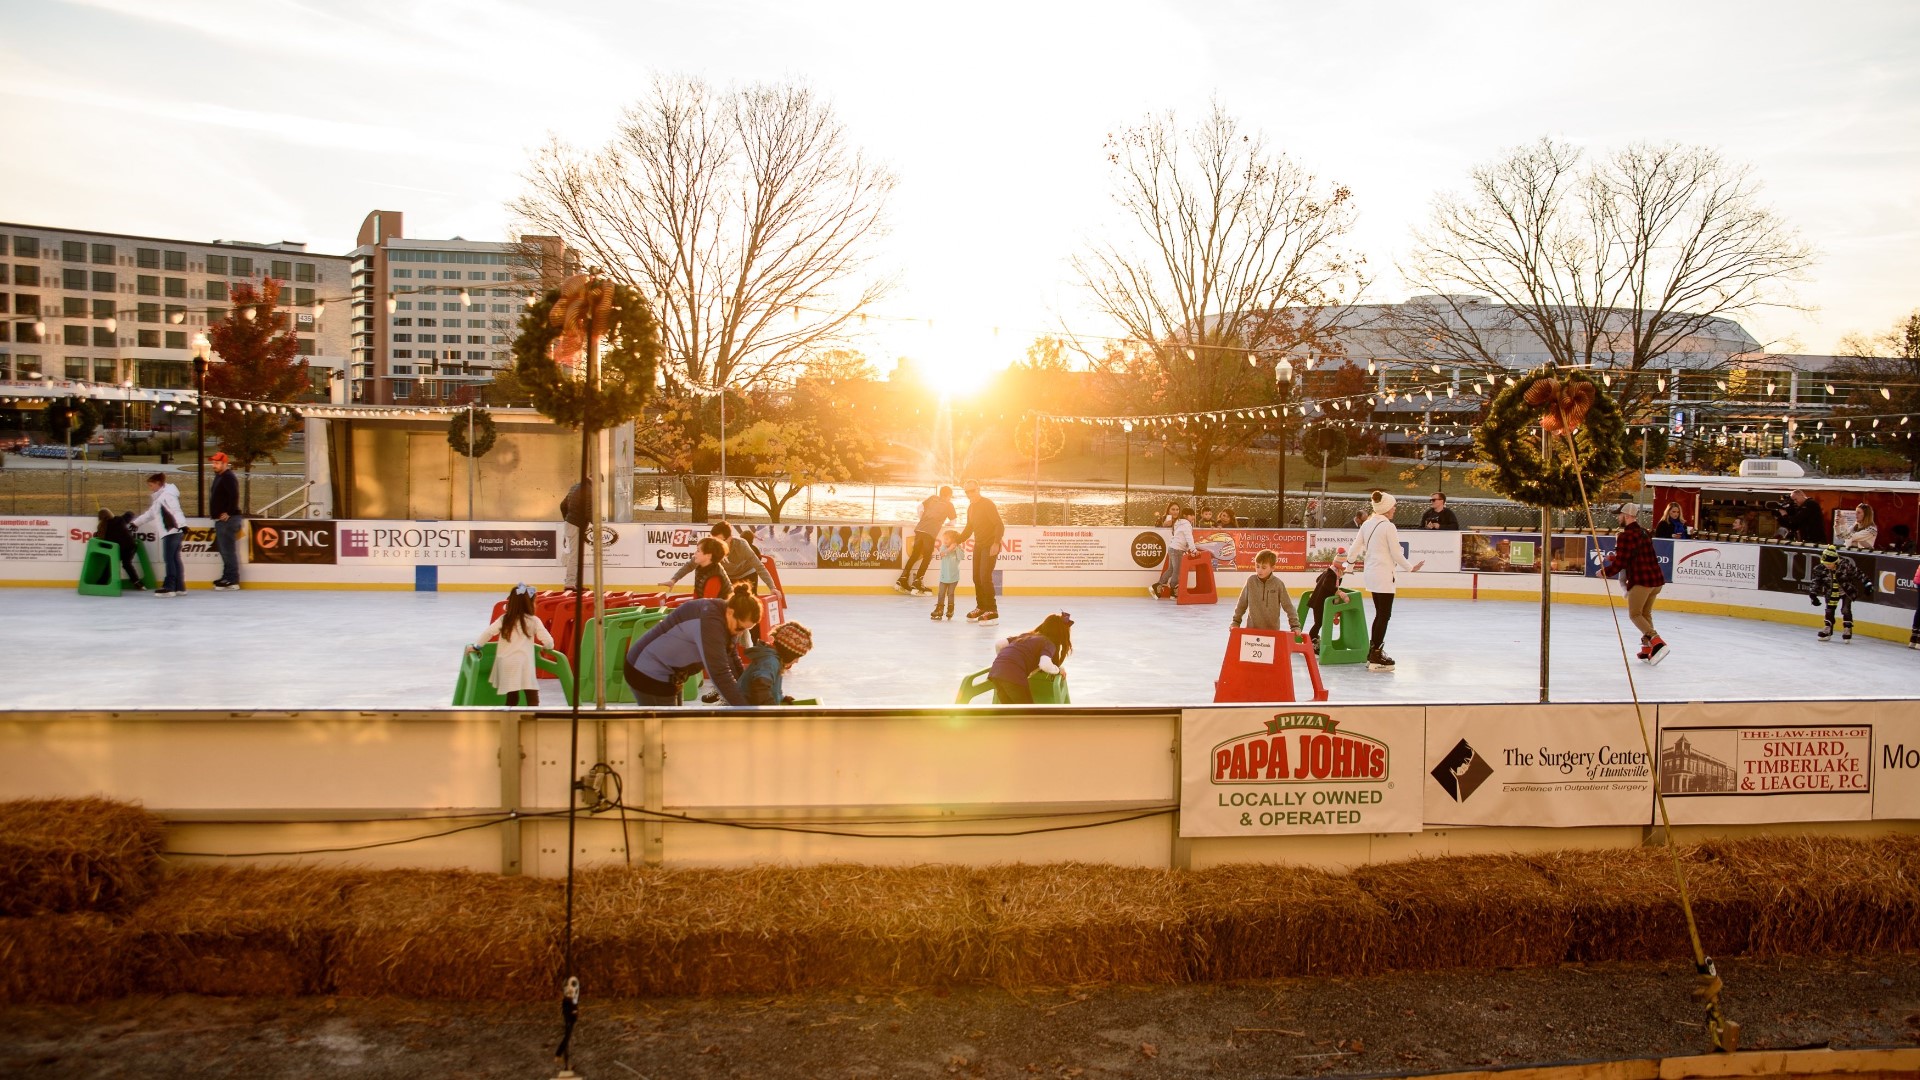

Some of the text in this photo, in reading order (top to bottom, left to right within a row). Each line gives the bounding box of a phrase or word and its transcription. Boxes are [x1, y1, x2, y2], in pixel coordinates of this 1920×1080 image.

[282, 530, 329, 547] PNC
[373, 529, 466, 548] PROPST
[510, 537, 549, 547] Sotheby's
[647, 531, 673, 544] WAAY
[673, 530, 691, 546] 31
[1273, 533, 1305, 542] Coupons
[1238, 541, 1245, 549] &
[1246, 541, 1267, 549] More,
[1270, 541, 1283, 549] Inc.
[1512, 546, 1521, 556] H
[373, 550, 466, 558] PROPERTIES
[656, 549, 695, 560] Cover
[823, 549, 849, 560] Blessed
[860, 550, 871, 558] the
[1690, 559, 1756, 572] HALL ALBRIGHT
[1676, 567, 1716, 576] GARRISON
[1725, 569, 1756, 579] BARNES
[1252, 650, 1262, 658] 20
[1280, 715, 1324, 727] PIZZA
[1773, 730, 1805, 738] LAW
[1850, 729, 1868, 737] OF
[1763, 741, 1849, 759] SINIARD,
[1215, 735, 1385, 780] PAPA JOHN'S
[1503, 746, 1648, 774] The Surgery Center
[1743, 757, 1860, 774] TIMBERLAKE
[1586, 765, 1649, 780] of Huntsville
[1564, 784, 1609, 793] Outpatient
[1612, 784, 1648, 793] Surgery
[1740, 774, 1868, 791] & LEAGUE, P.C.
[1218, 790, 1383, 807] LOCALLY OWNED
[1239, 810, 1361, 826] & OPERATED
